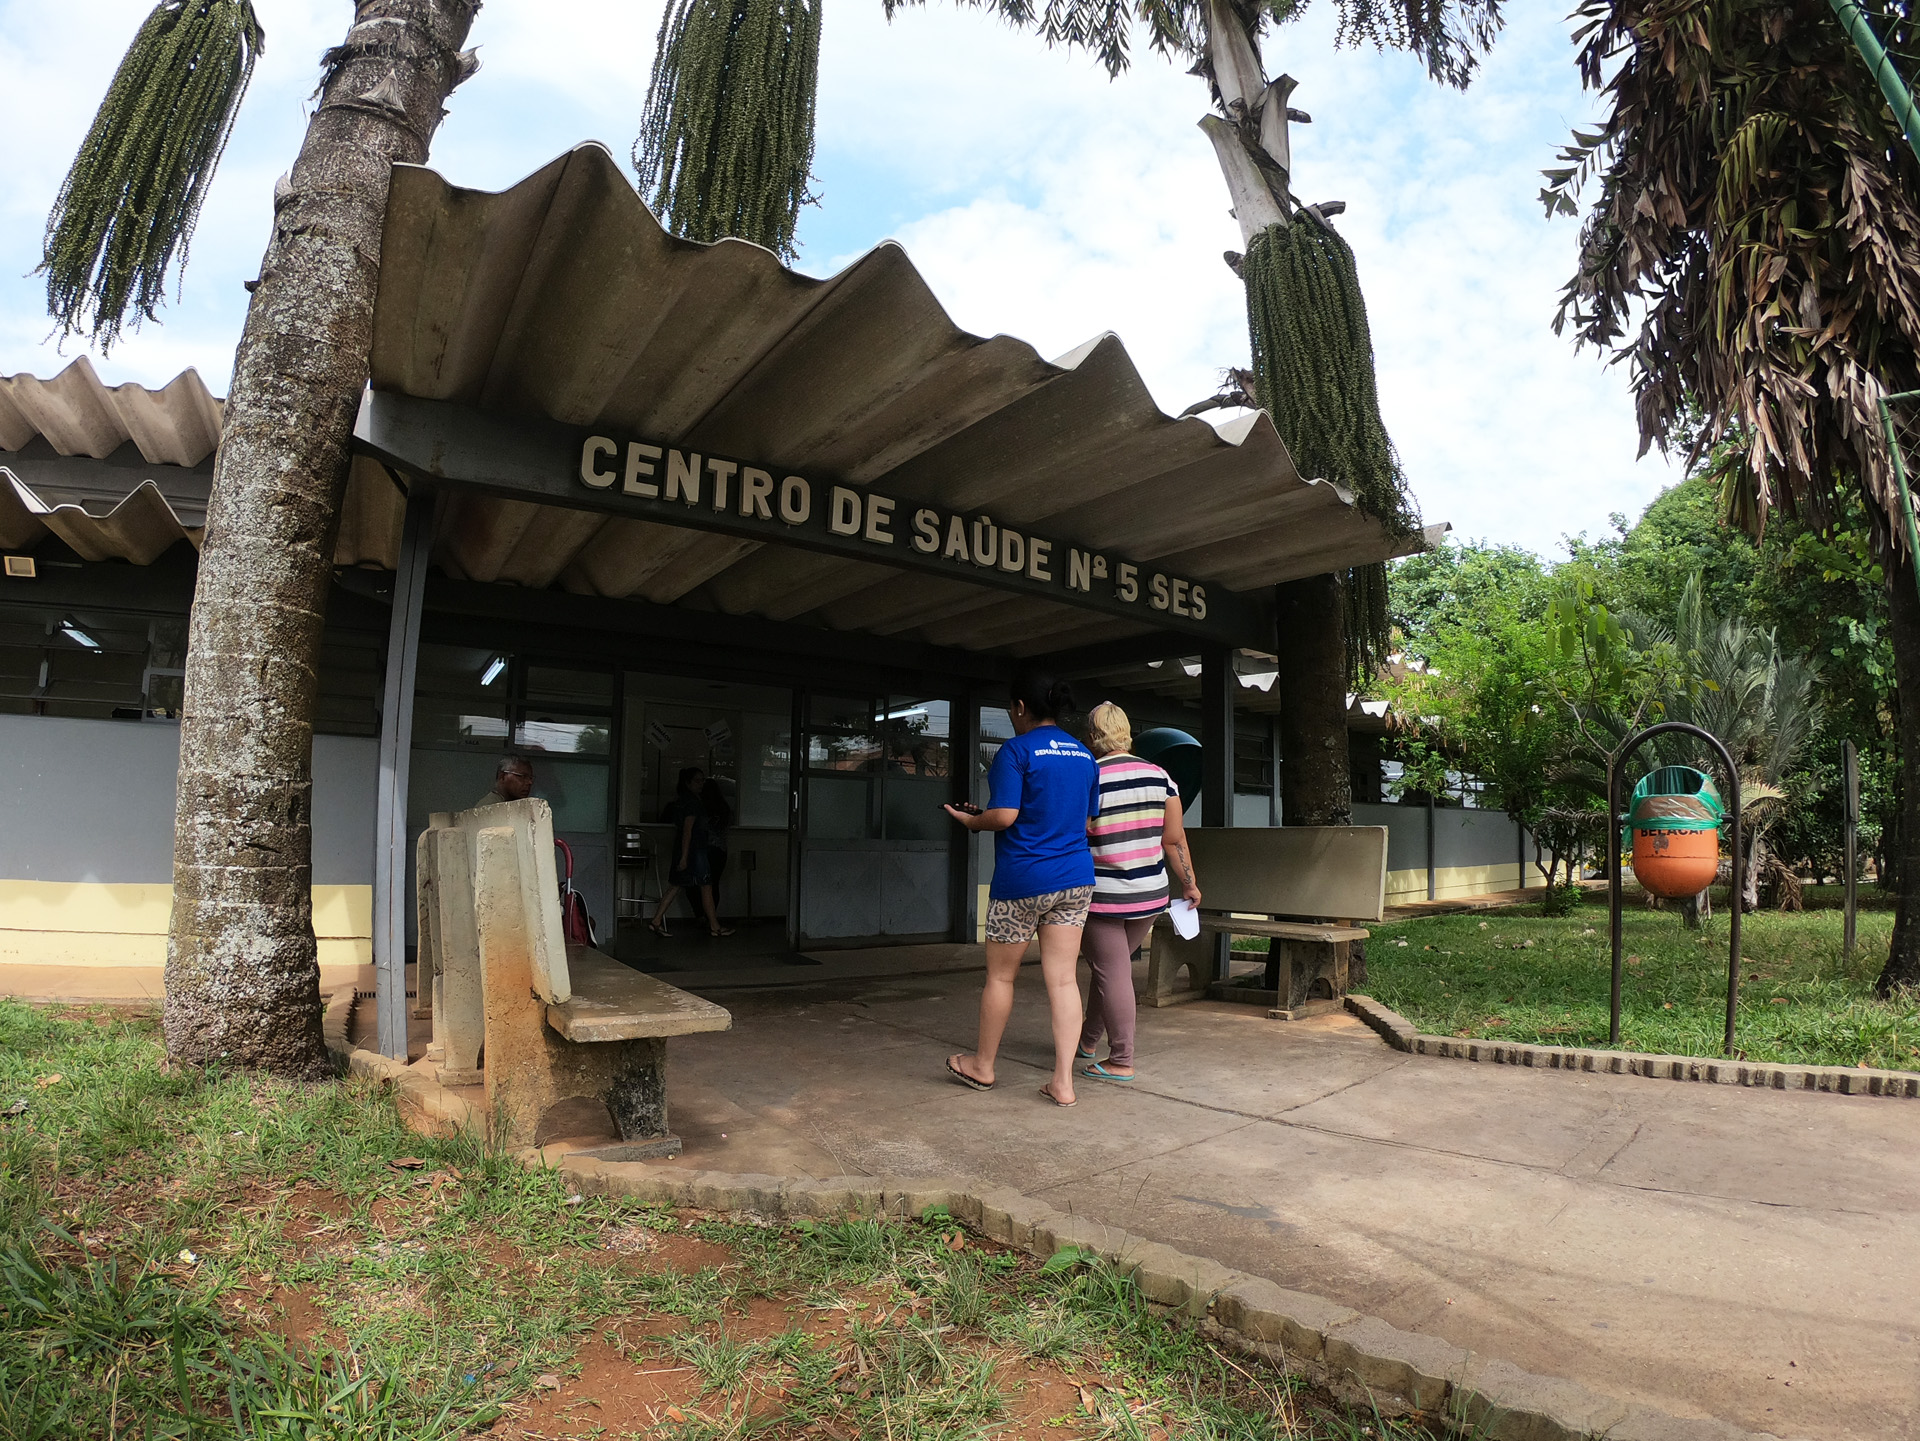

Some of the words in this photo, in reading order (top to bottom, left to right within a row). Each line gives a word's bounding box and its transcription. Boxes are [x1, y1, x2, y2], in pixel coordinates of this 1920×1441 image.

[580, 435, 811, 525] CENTRO
[828, 486, 895, 544] DE
[1116, 563, 1139, 602] 5
[1148, 573, 1207, 620] SES
[1034, 748, 1061, 757] SEMANA
